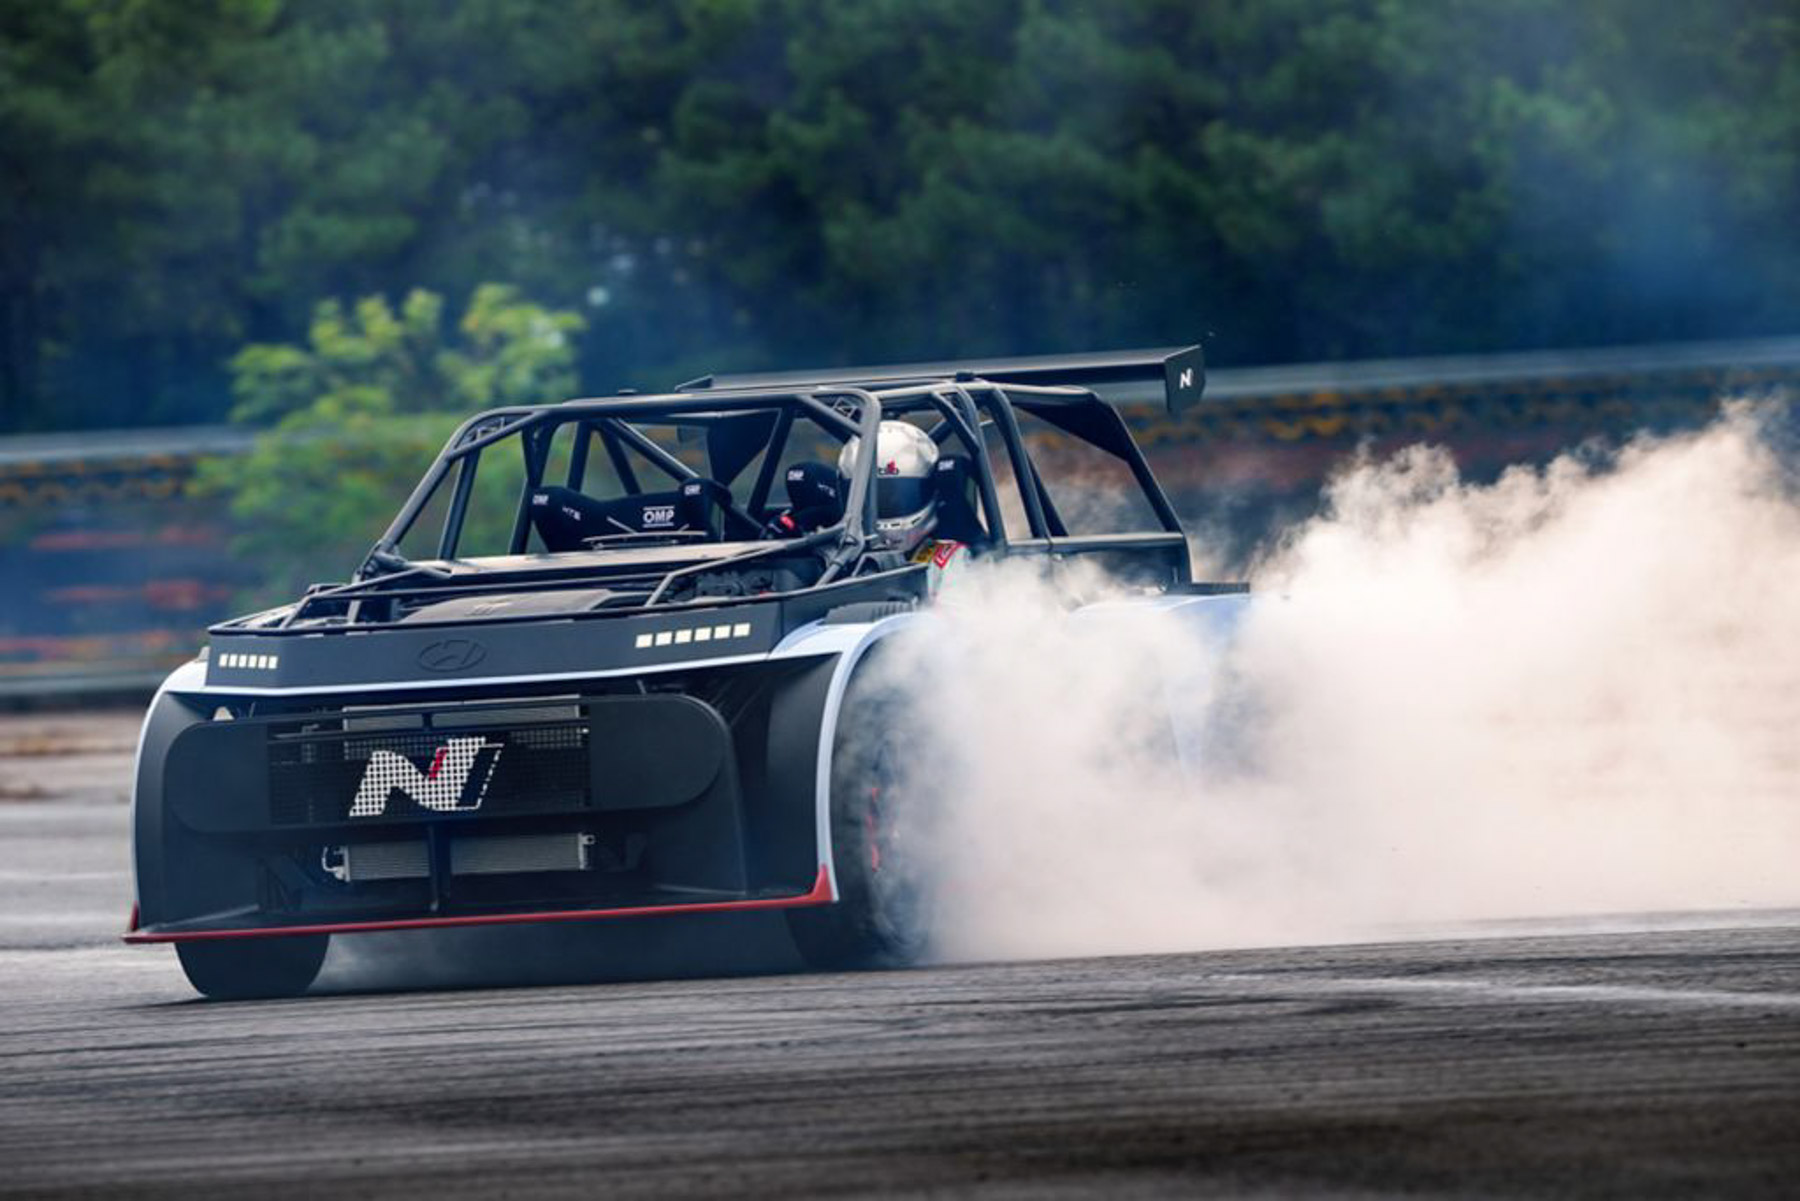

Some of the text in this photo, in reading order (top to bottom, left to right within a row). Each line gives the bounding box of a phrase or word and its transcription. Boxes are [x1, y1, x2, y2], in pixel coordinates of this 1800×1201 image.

[1180, 368, 1193, 389] N
[643, 509, 674, 523] OMP
[349, 737, 504, 816] N
